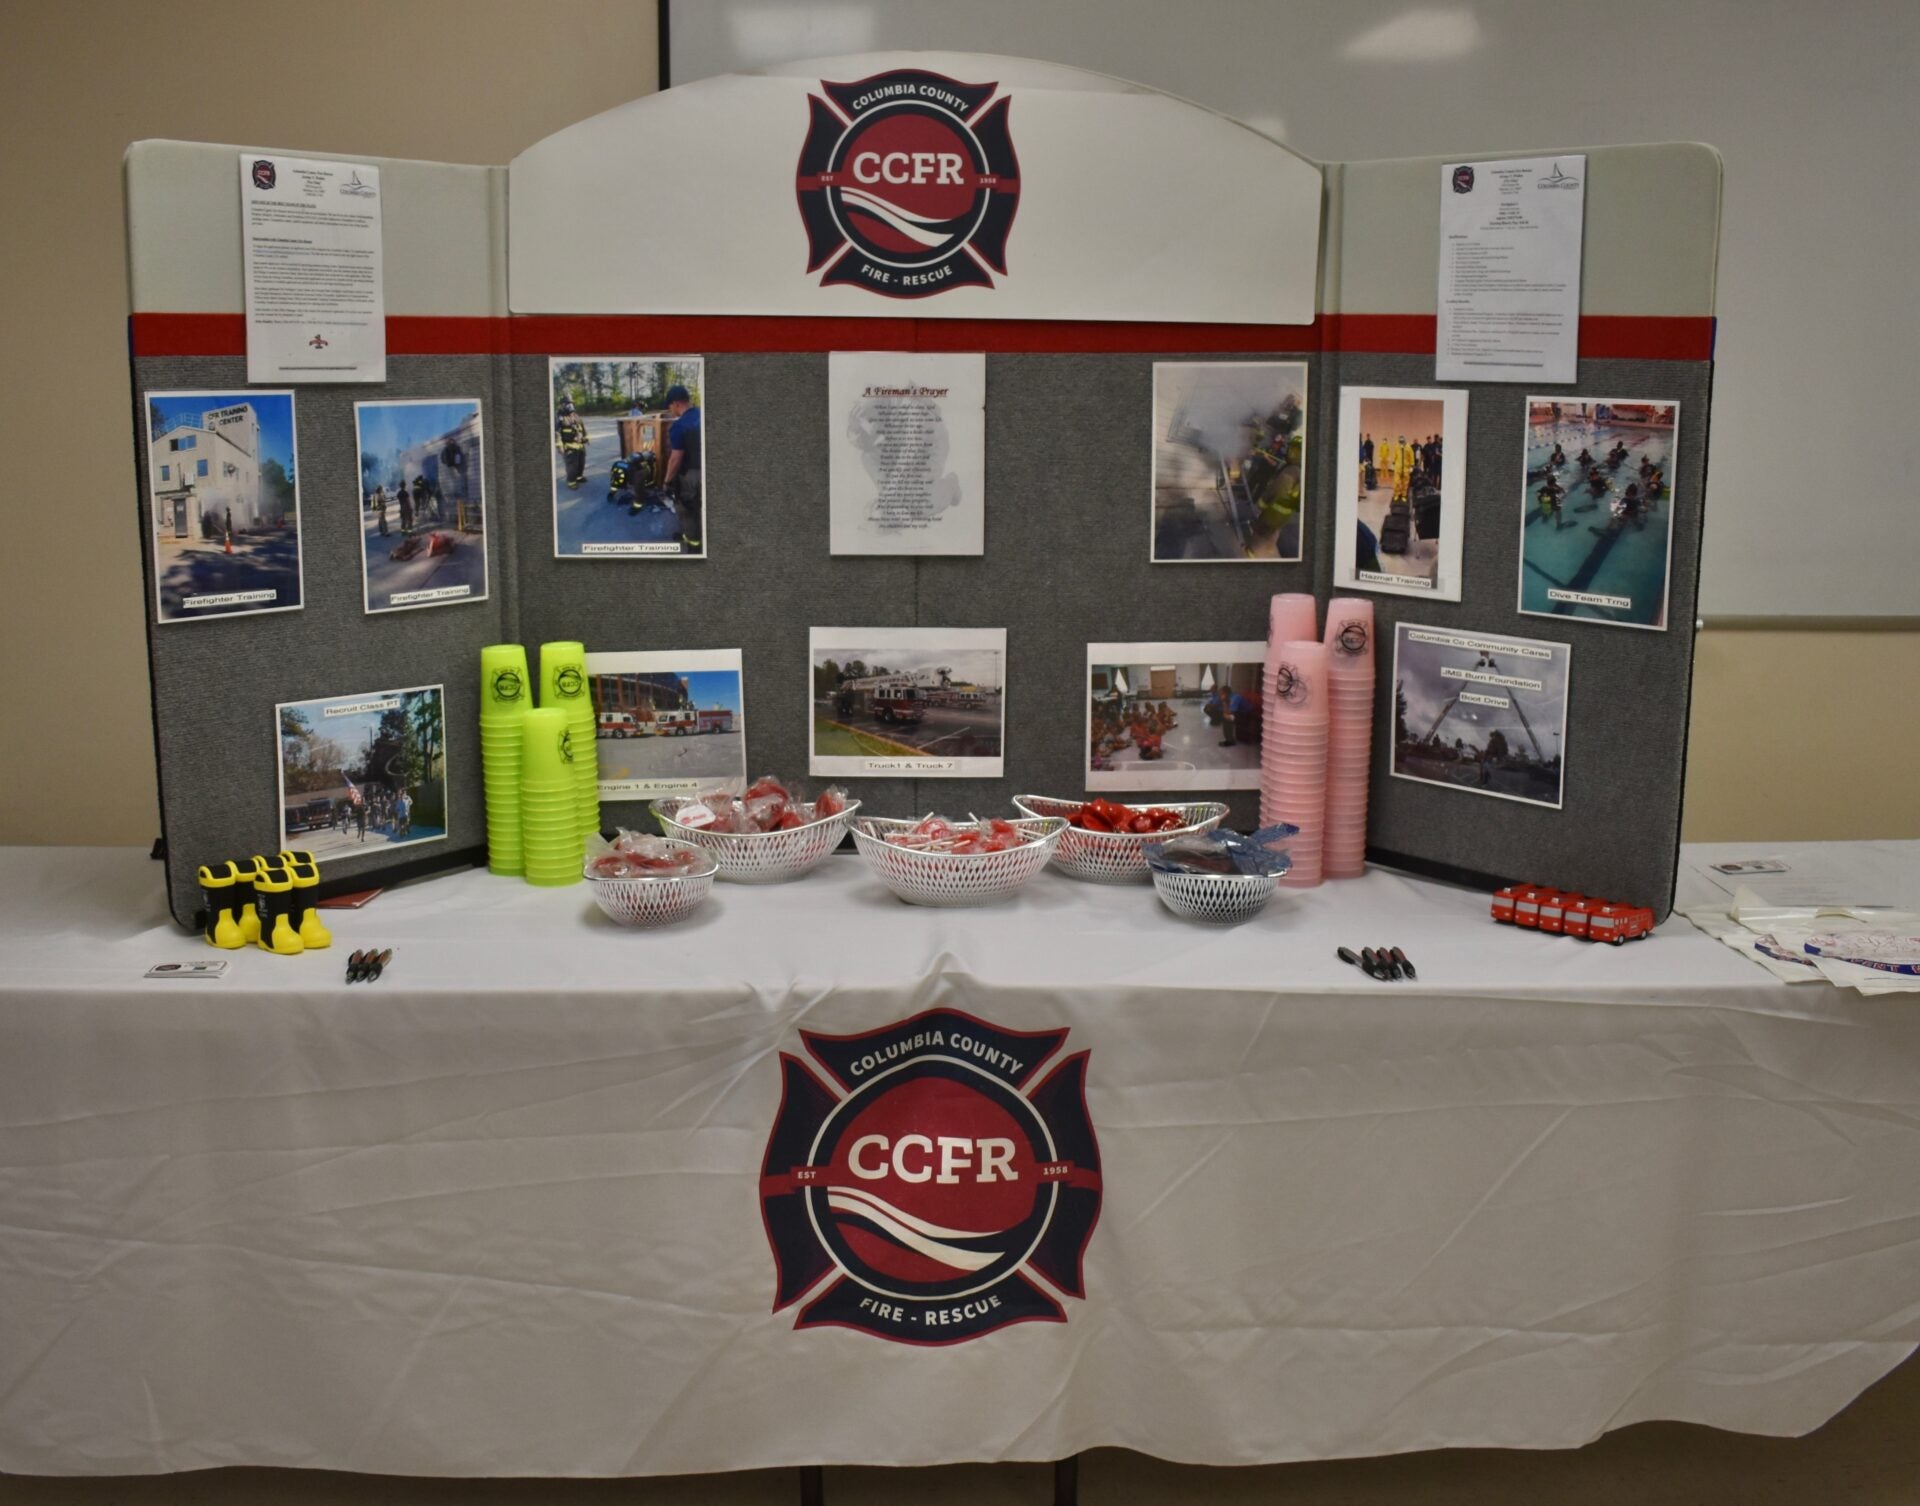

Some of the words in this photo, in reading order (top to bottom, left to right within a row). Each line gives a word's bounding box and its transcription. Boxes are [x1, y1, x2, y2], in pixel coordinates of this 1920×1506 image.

[852, 84, 916, 110] COLUMBIA
[919, 85, 970, 112] COUNTY
[853, 152, 965, 185] CCFR
[861, 264, 890, 283] FIRE
[903, 265, 953, 286] RESCUE
[862, 387, 871, 397] A
[874, 385, 918, 395] Fireman's
[920, 387, 949, 398] Prayer
[638, 544, 679, 552] Training
[1361, 572, 1393, 582] Hazmat
[1396, 577, 1430, 586] Training
[184, 597, 233, 606] Firefighter
[237, 592, 275, 600] Training
[391, 593, 433, 602] Firefighter
[437, 588, 469, 596] Training
[1549, 591, 1571, 599] Dive
[1574, 593, 1603, 602] Team
[1409, 632, 1450, 643] Columbia
[1452, 638, 1465, 646] Co
[1467, 641, 1519, 653] Community
[1521, 648, 1550, 658] Cares
[1465, 672, 1487, 681] Burn
[1488, 676, 1540, 688] Foundation
[1461, 693, 1482, 703] Boot
[1484, 697, 1508, 707] Drive
[326, 706, 358, 715] Recruit
[359, 703, 385, 712] Class
[850, 1030, 945, 1076] COLUMBIA
[950, 1033, 1024, 1075] COUNTY
[848, 1134, 1019, 1185] CCFR
[797, 1171, 816, 1179] EST
[1043, 1165, 1068, 1176] 1958
[859, 1297, 904, 1322] FIRE
[925, 1295, 1001, 1326] RESCUE
